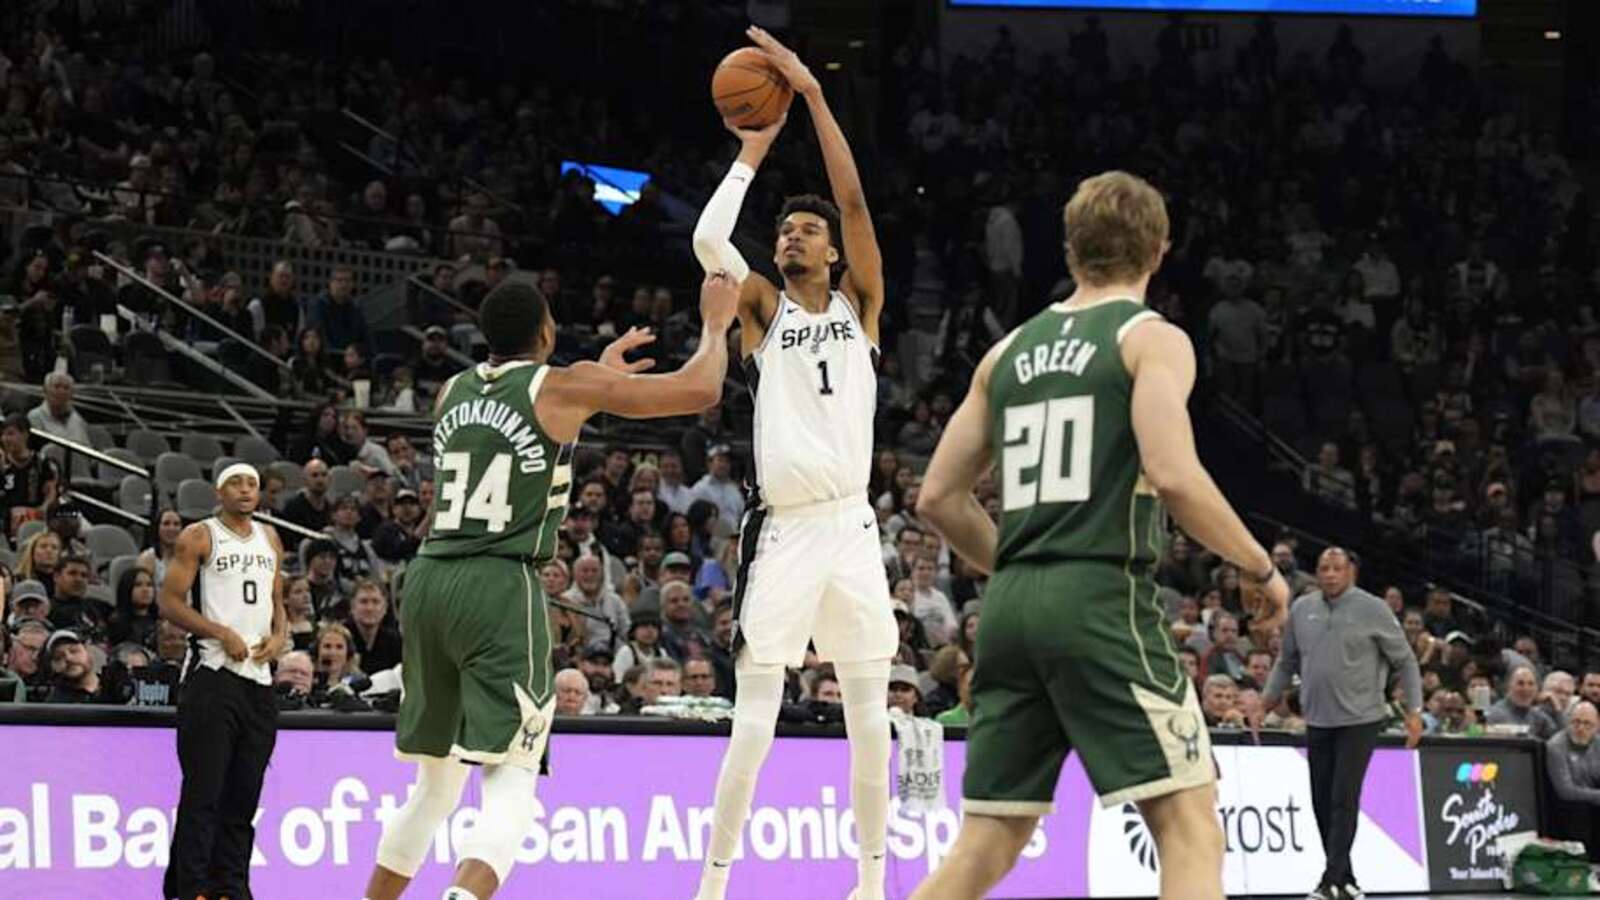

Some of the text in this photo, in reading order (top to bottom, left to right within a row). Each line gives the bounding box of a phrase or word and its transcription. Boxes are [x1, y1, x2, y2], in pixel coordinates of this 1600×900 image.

[817, 361, 833, 395] 1
[1014, 338, 1098, 385] GREEN
[1003, 395, 1095, 512] 20
[434, 452, 513, 532] 34
[243, 580, 257, 605] 0
[280, 776, 370, 866] of
[1218, 794, 1304, 854] rost
